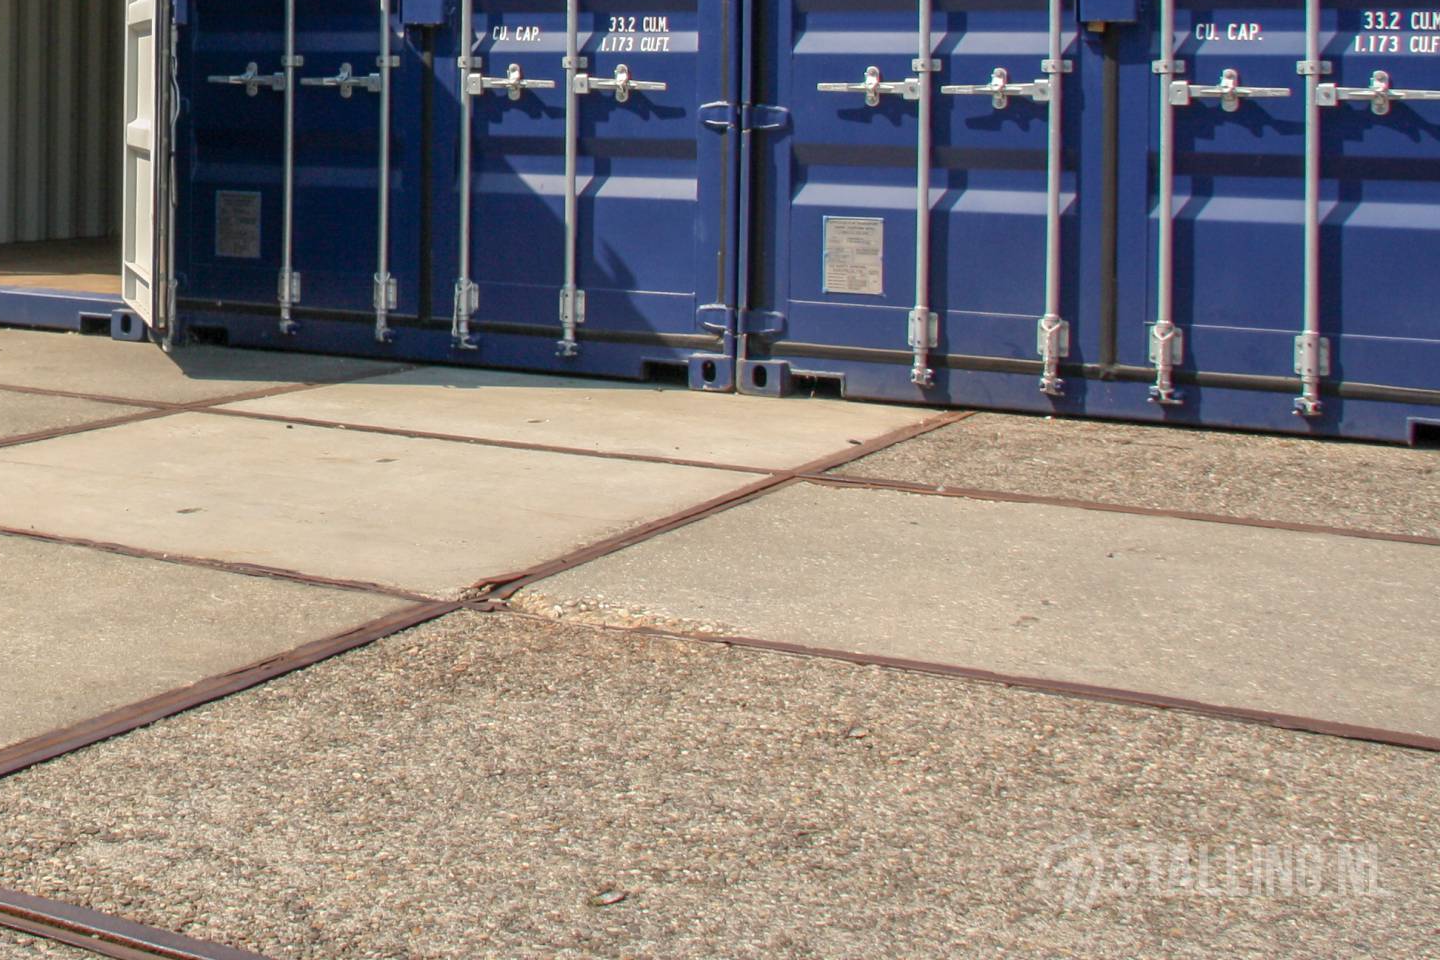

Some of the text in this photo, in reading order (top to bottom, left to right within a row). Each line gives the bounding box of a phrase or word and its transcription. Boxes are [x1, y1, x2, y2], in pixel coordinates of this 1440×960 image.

[609, 17, 635, 32] 33.2
[1364, 11, 1400, 30] 33.2
[493, 26, 541, 41] CU. CAP.
[1195, 23, 1263, 41] CU. CAP.
[601, 37, 633, 51] 1.173
[1354, 35, 1399, 52] 1.173
